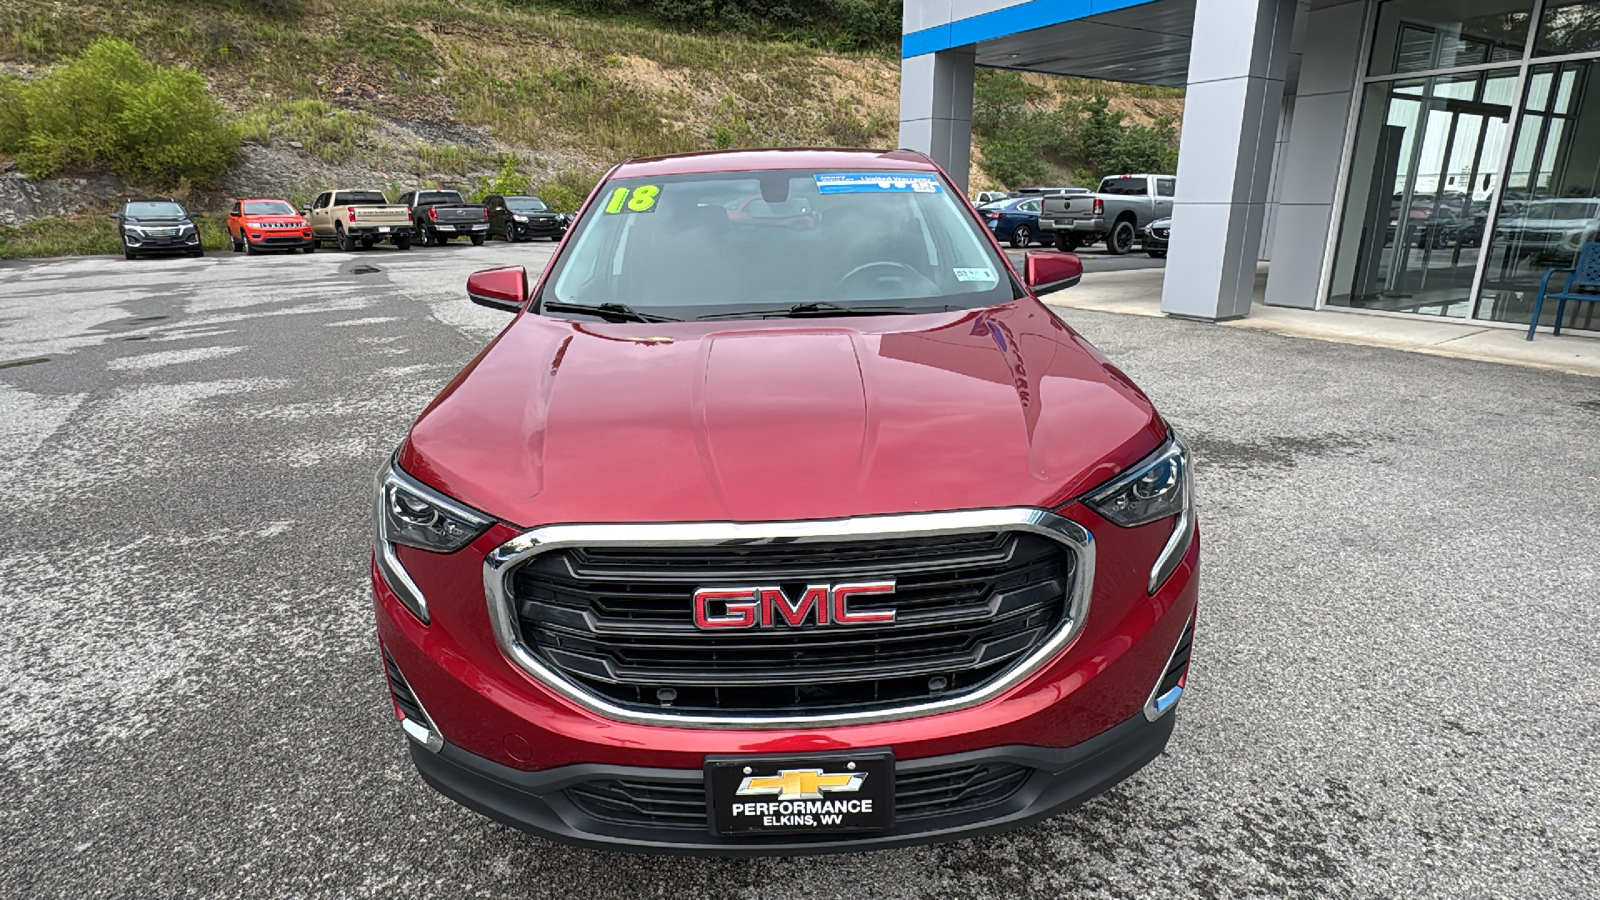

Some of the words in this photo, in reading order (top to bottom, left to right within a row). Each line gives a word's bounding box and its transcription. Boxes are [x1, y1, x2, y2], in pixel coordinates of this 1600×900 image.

[605, 185, 660, 214] 18
[692, 580, 897, 630] GMC
[732, 800, 873, 816] PERFORMANCE
[763, 816, 818, 827] ELKINS,
[820, 814, 843, 825] WV
